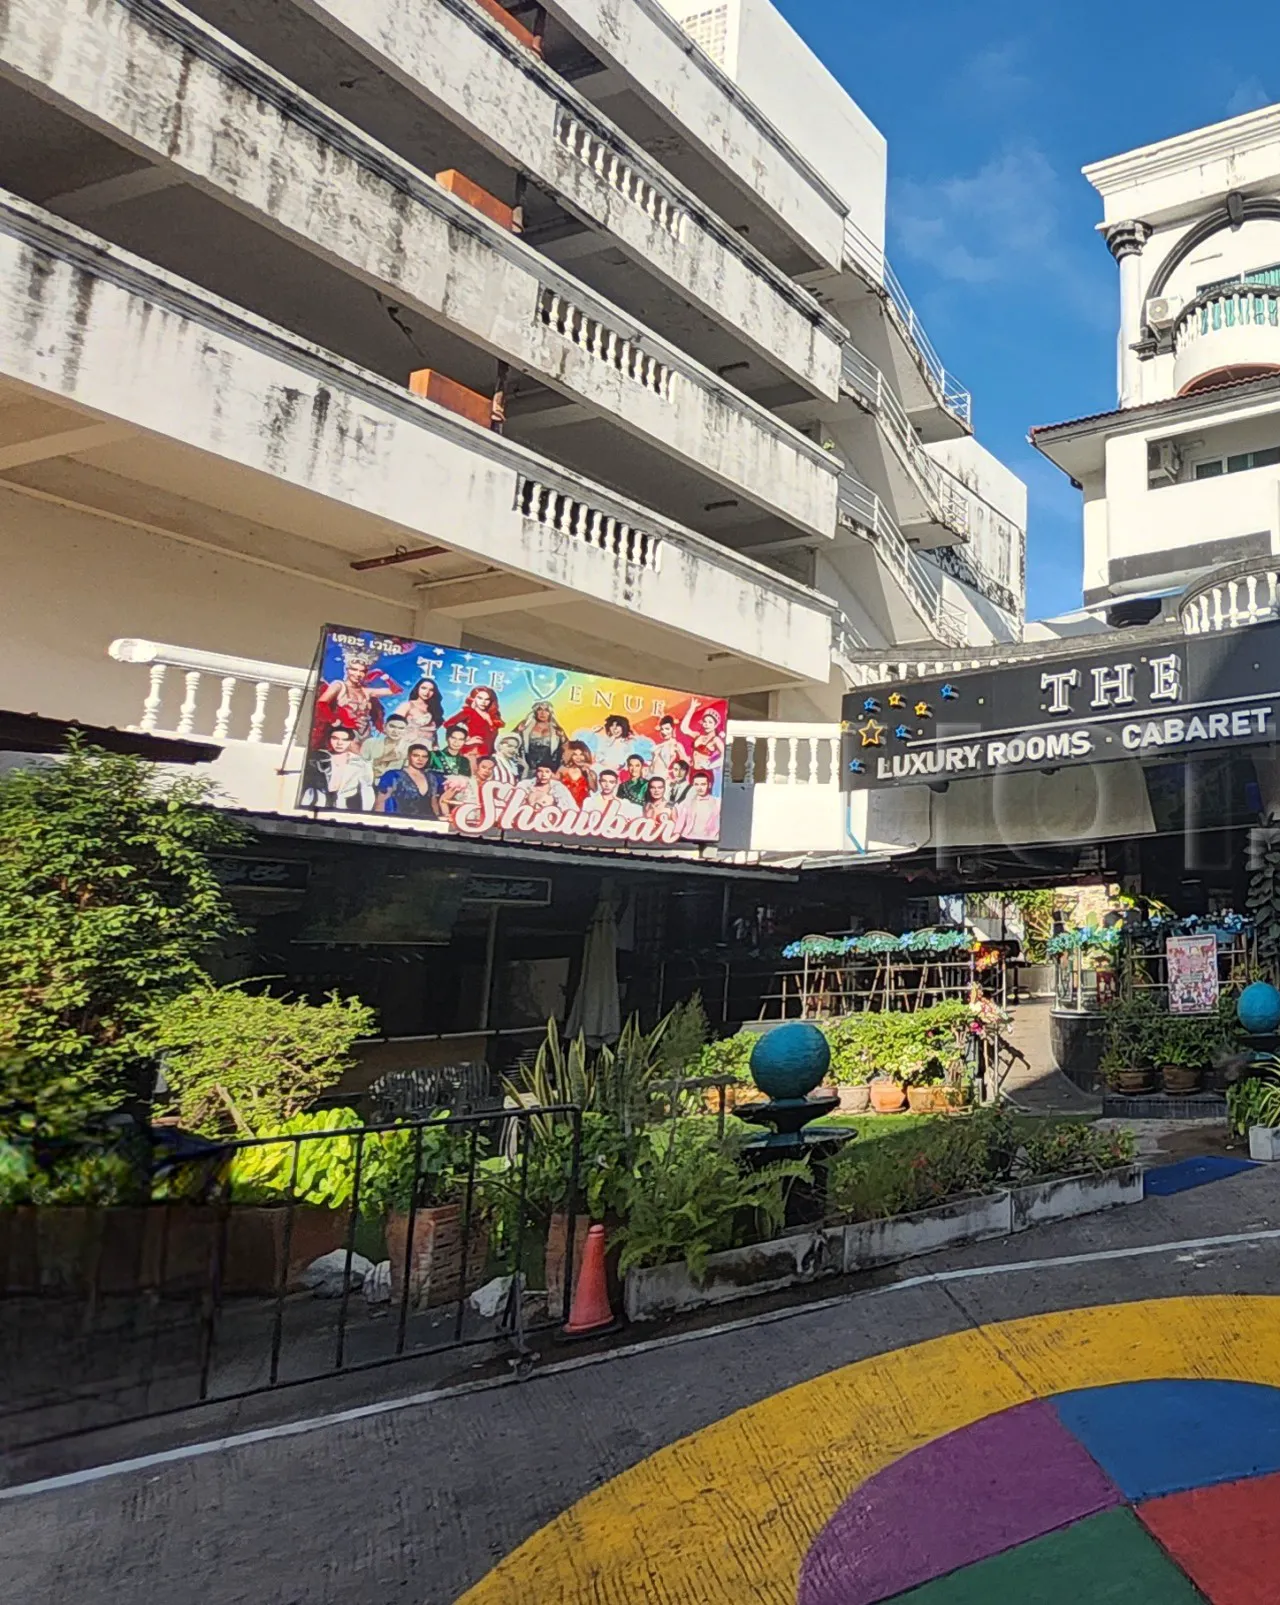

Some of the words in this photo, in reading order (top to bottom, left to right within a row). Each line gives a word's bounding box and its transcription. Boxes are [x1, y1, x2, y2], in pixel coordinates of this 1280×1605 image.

[416, 656, 505, 691] THE
[522, 667, 667, 718] VENUE
[1041, 654, 1182, 713] THE
[877, 743, 980, 780] LUXURY
[986, 730, 1094, 767] ROOMS
[1121, 706, 1272, 750] CABARET
[452, 780, 683, 845] Showbar
